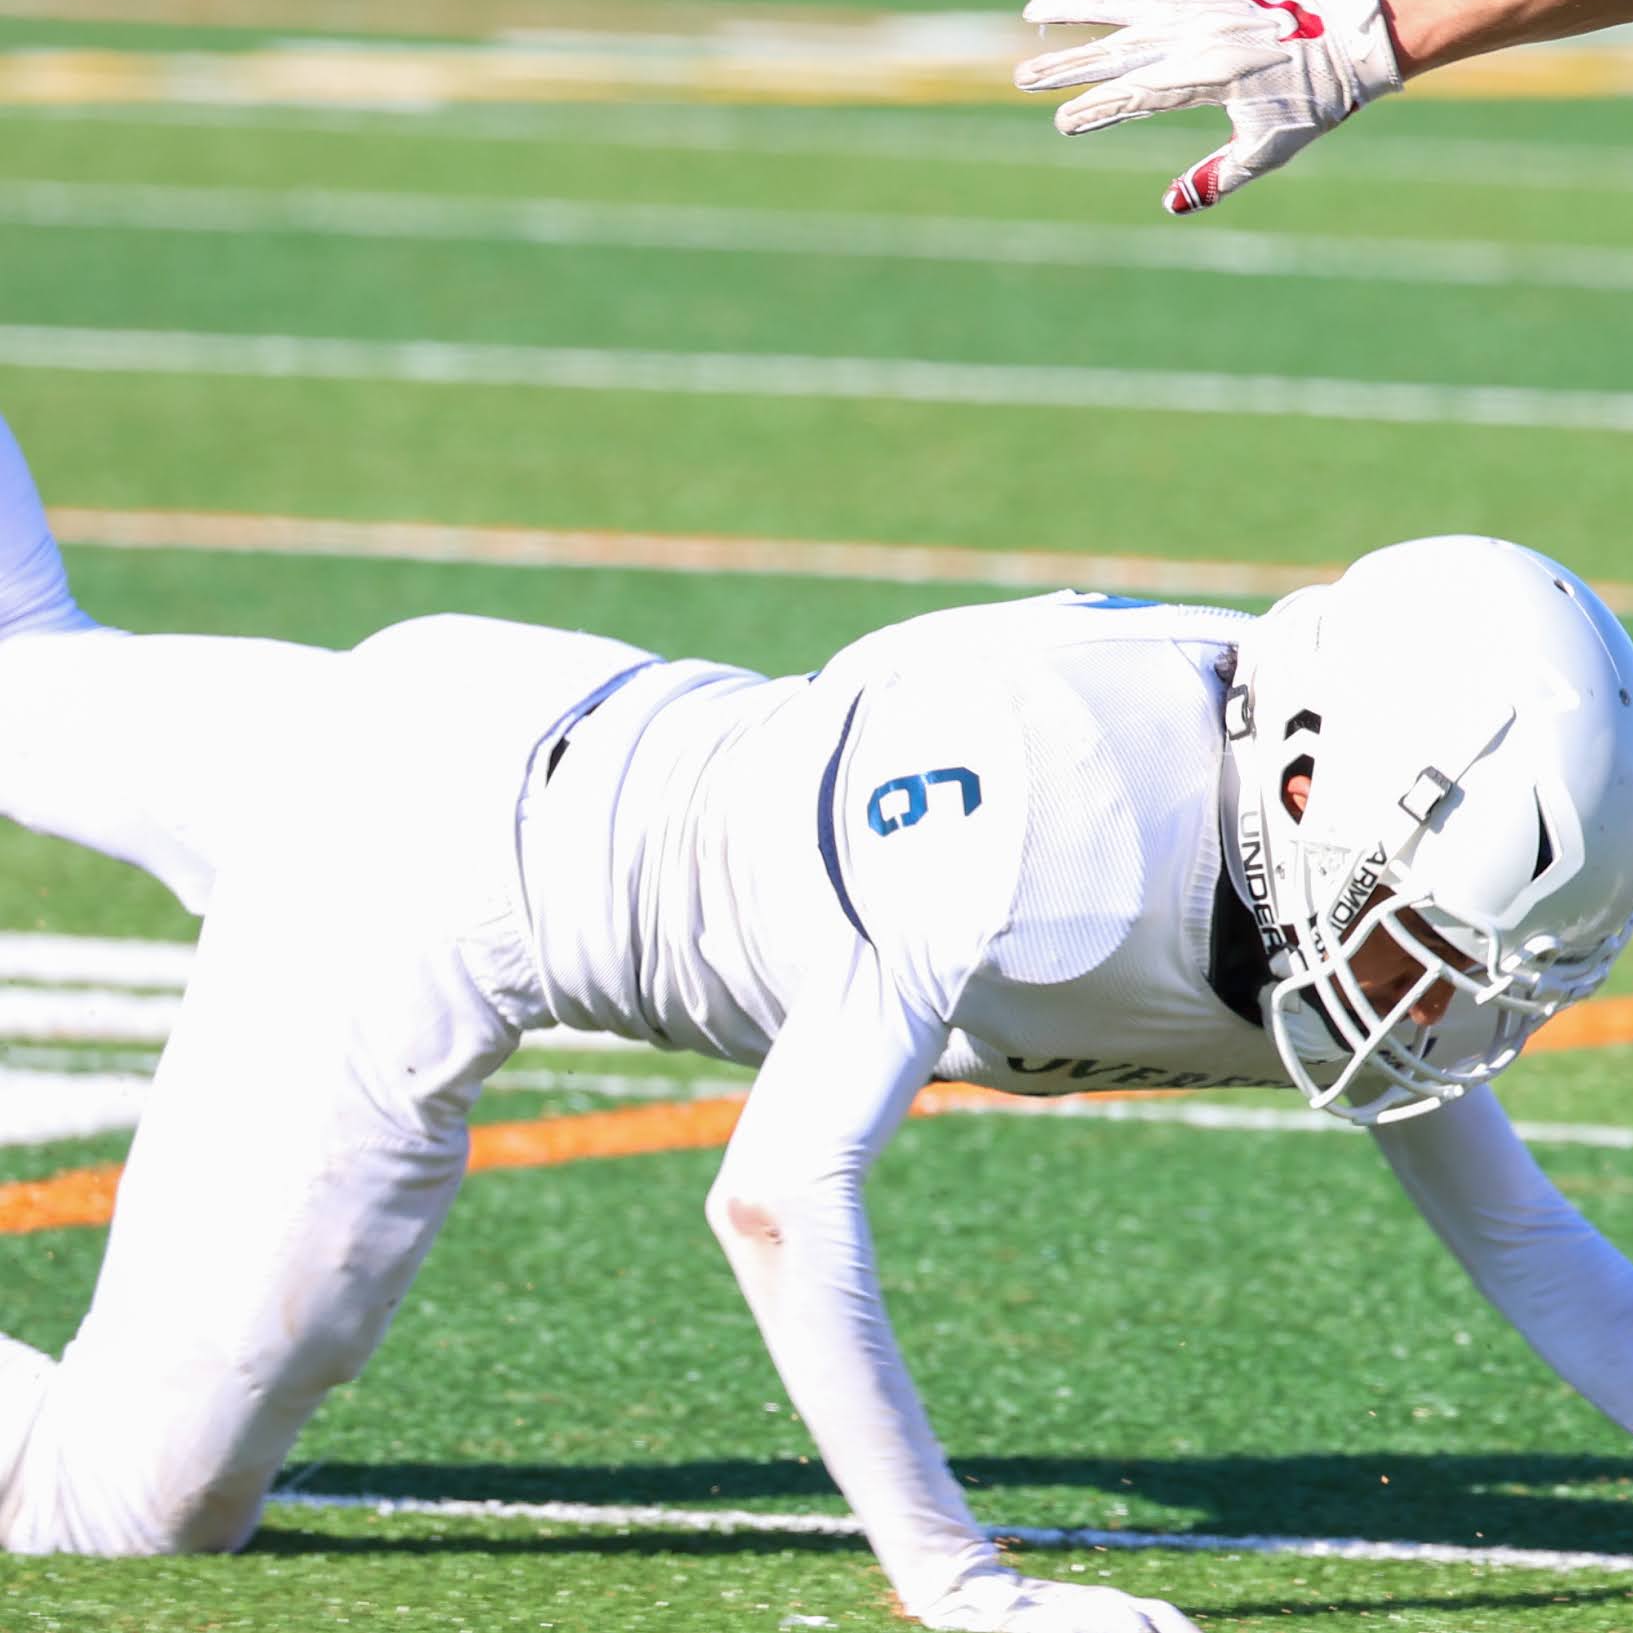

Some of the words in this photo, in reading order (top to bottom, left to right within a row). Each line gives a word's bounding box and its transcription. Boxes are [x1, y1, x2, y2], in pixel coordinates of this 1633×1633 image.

[866, 765, 983, 838] 6
[1239, 810, 1292, 957] UNDER
[1329, 839, 1388, 934] ARMO
